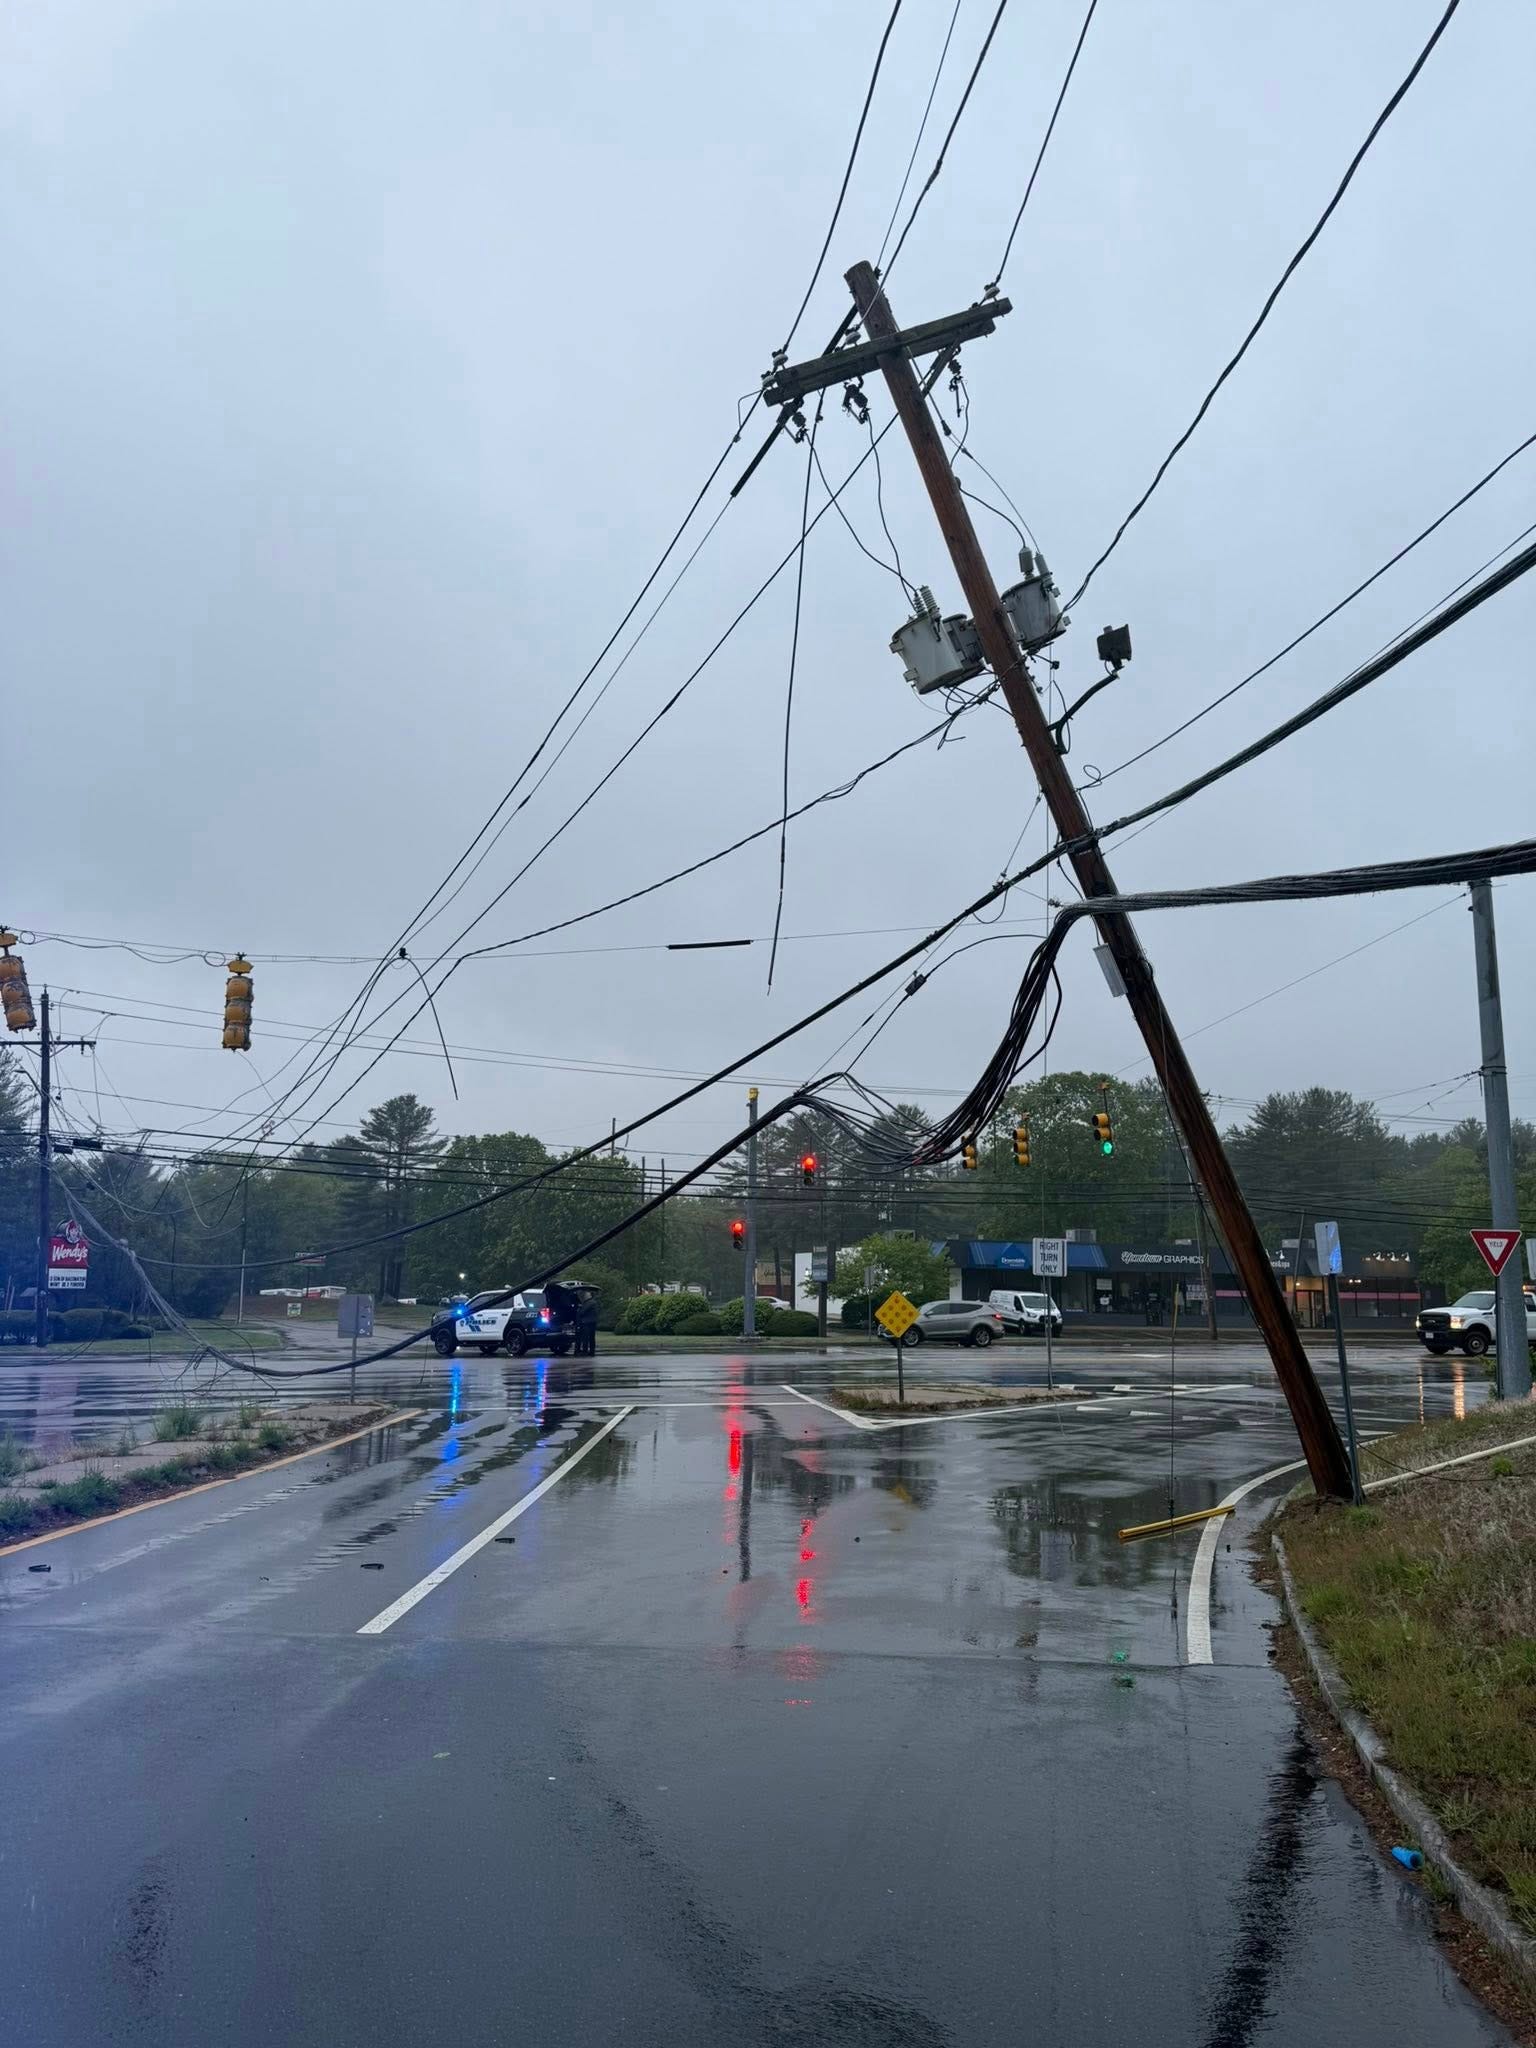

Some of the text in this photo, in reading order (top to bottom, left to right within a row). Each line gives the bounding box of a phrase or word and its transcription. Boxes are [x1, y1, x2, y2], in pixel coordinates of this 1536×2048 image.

[1040, 1242, 1058, 1250] RIGHT
[52, 1243, 88, 1262] Wendy's
[1040, 1253, 1058, 1262] TURN
[1163, 1255, 1204, 1264] GRAPHICS
[1040, 1264, 1057, 1273] ONLY
